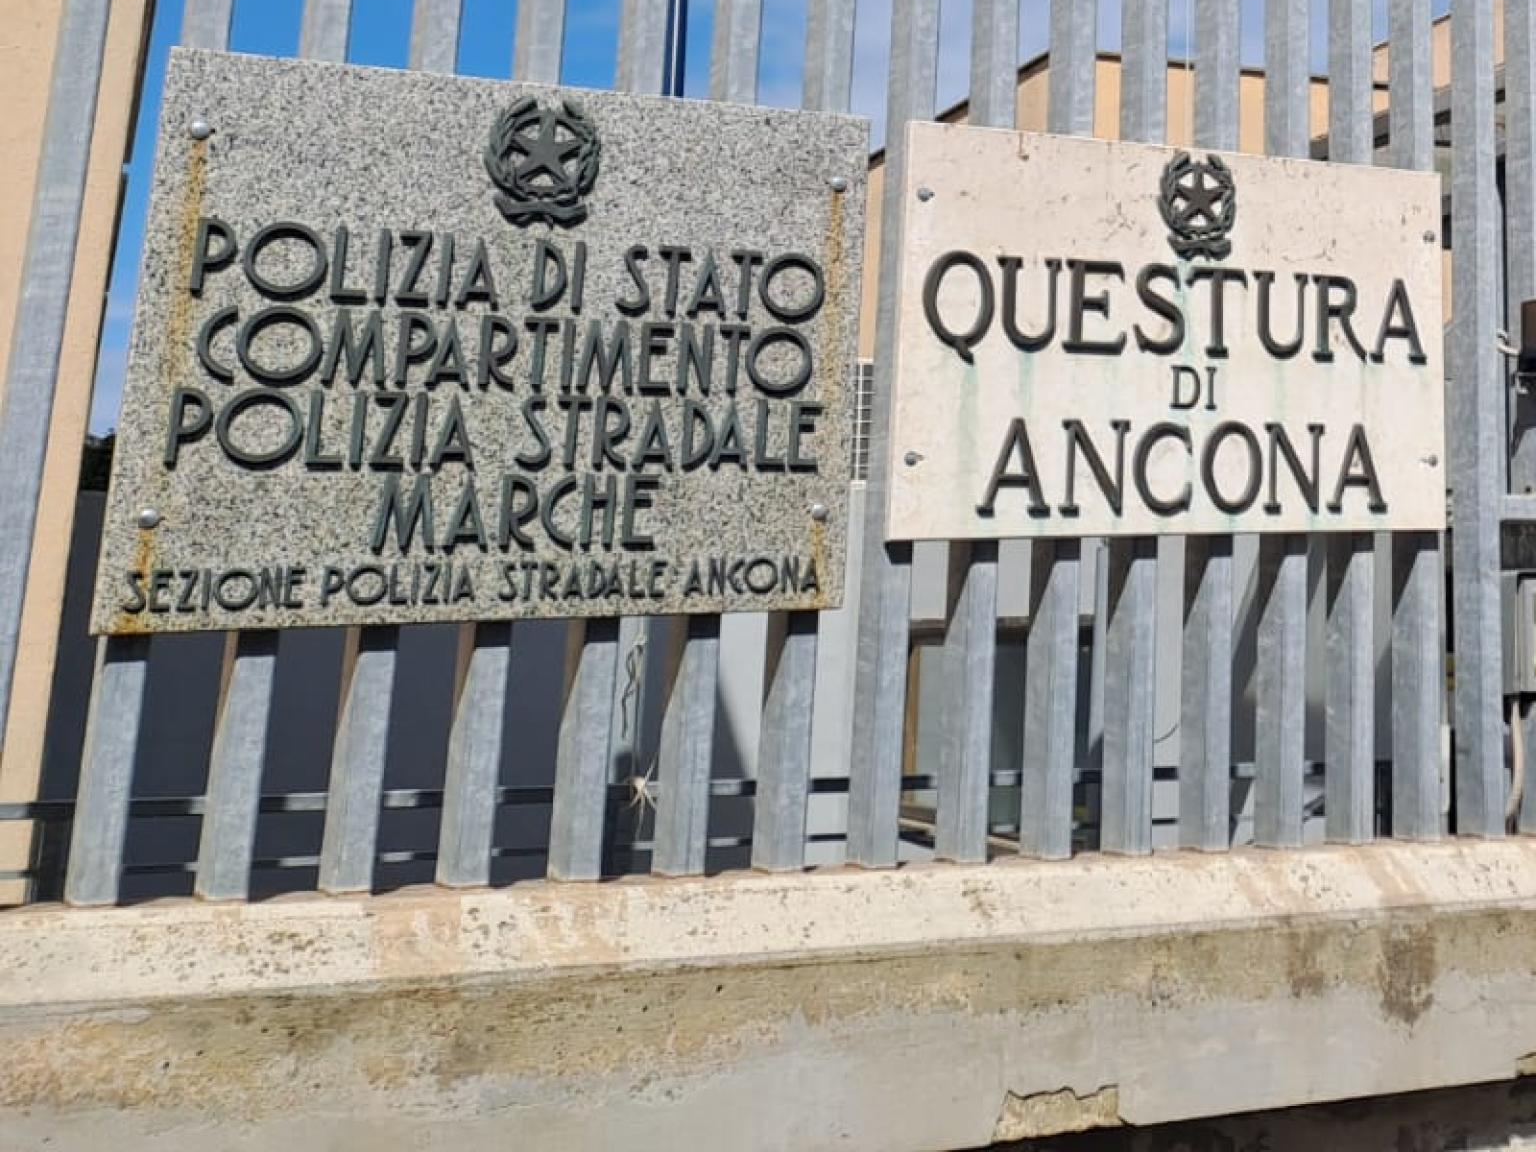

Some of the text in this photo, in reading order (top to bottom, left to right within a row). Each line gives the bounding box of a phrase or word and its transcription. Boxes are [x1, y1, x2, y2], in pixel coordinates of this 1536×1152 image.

[188, 218, 827, 321] POLIZIA DI STATO
[921, 250, 1427, 365] QUESTURA
[196, 304, 814, 397] COMPARTIMENTO
[1170, 365, 1217, 411] DI
[163, 386, 825, 473] POLIZIA STRADALE
[975, 417, 1388, 518] ANCONA
[371, 473, 663, 554] MARCHE
[122, 554, 821, 614] SEZIONE POLIZIA STRADALE ANCONA
